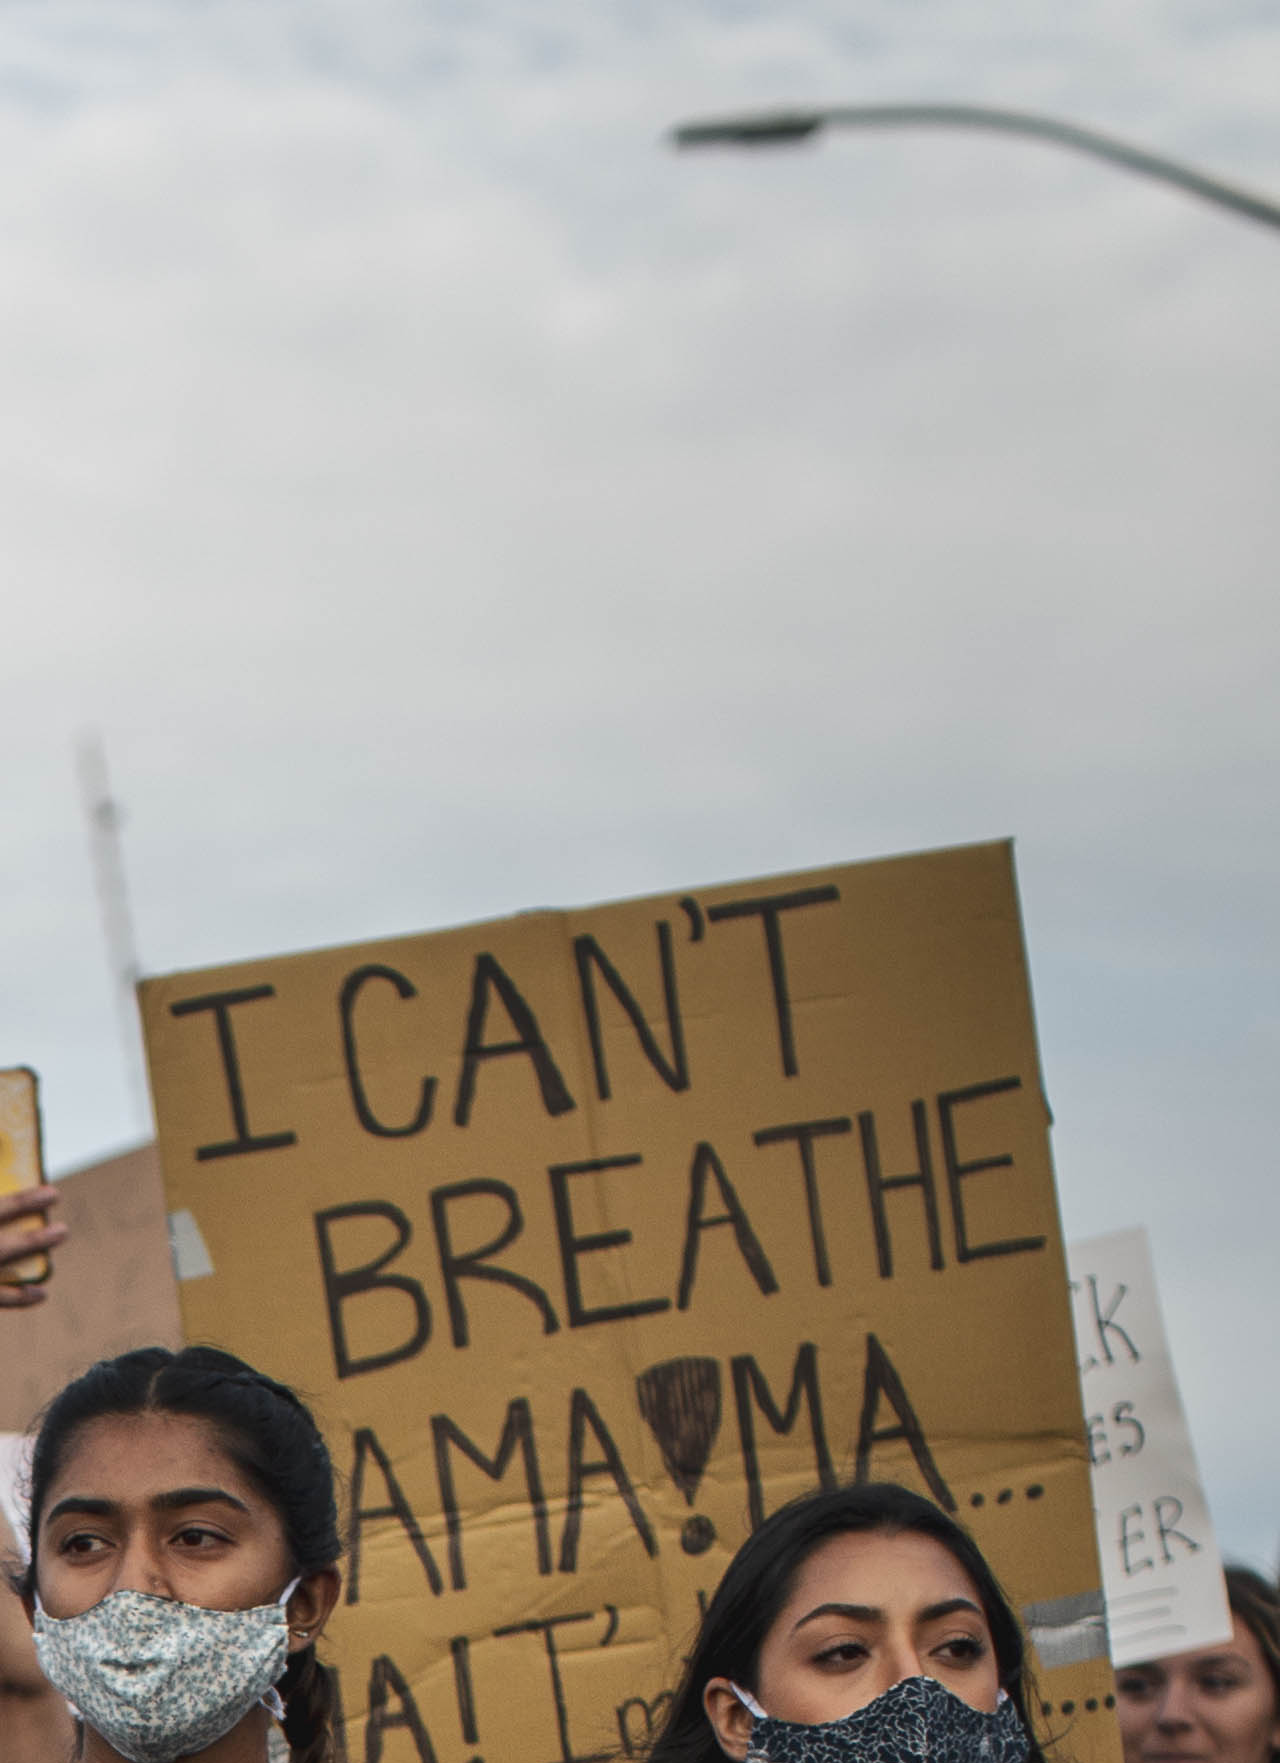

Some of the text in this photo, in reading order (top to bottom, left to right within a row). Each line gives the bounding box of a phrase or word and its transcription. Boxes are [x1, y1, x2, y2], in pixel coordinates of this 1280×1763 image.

[169, 884, 842, 1162] I CAN'T
[312, 1076, 1048, 1380] BREATHE
